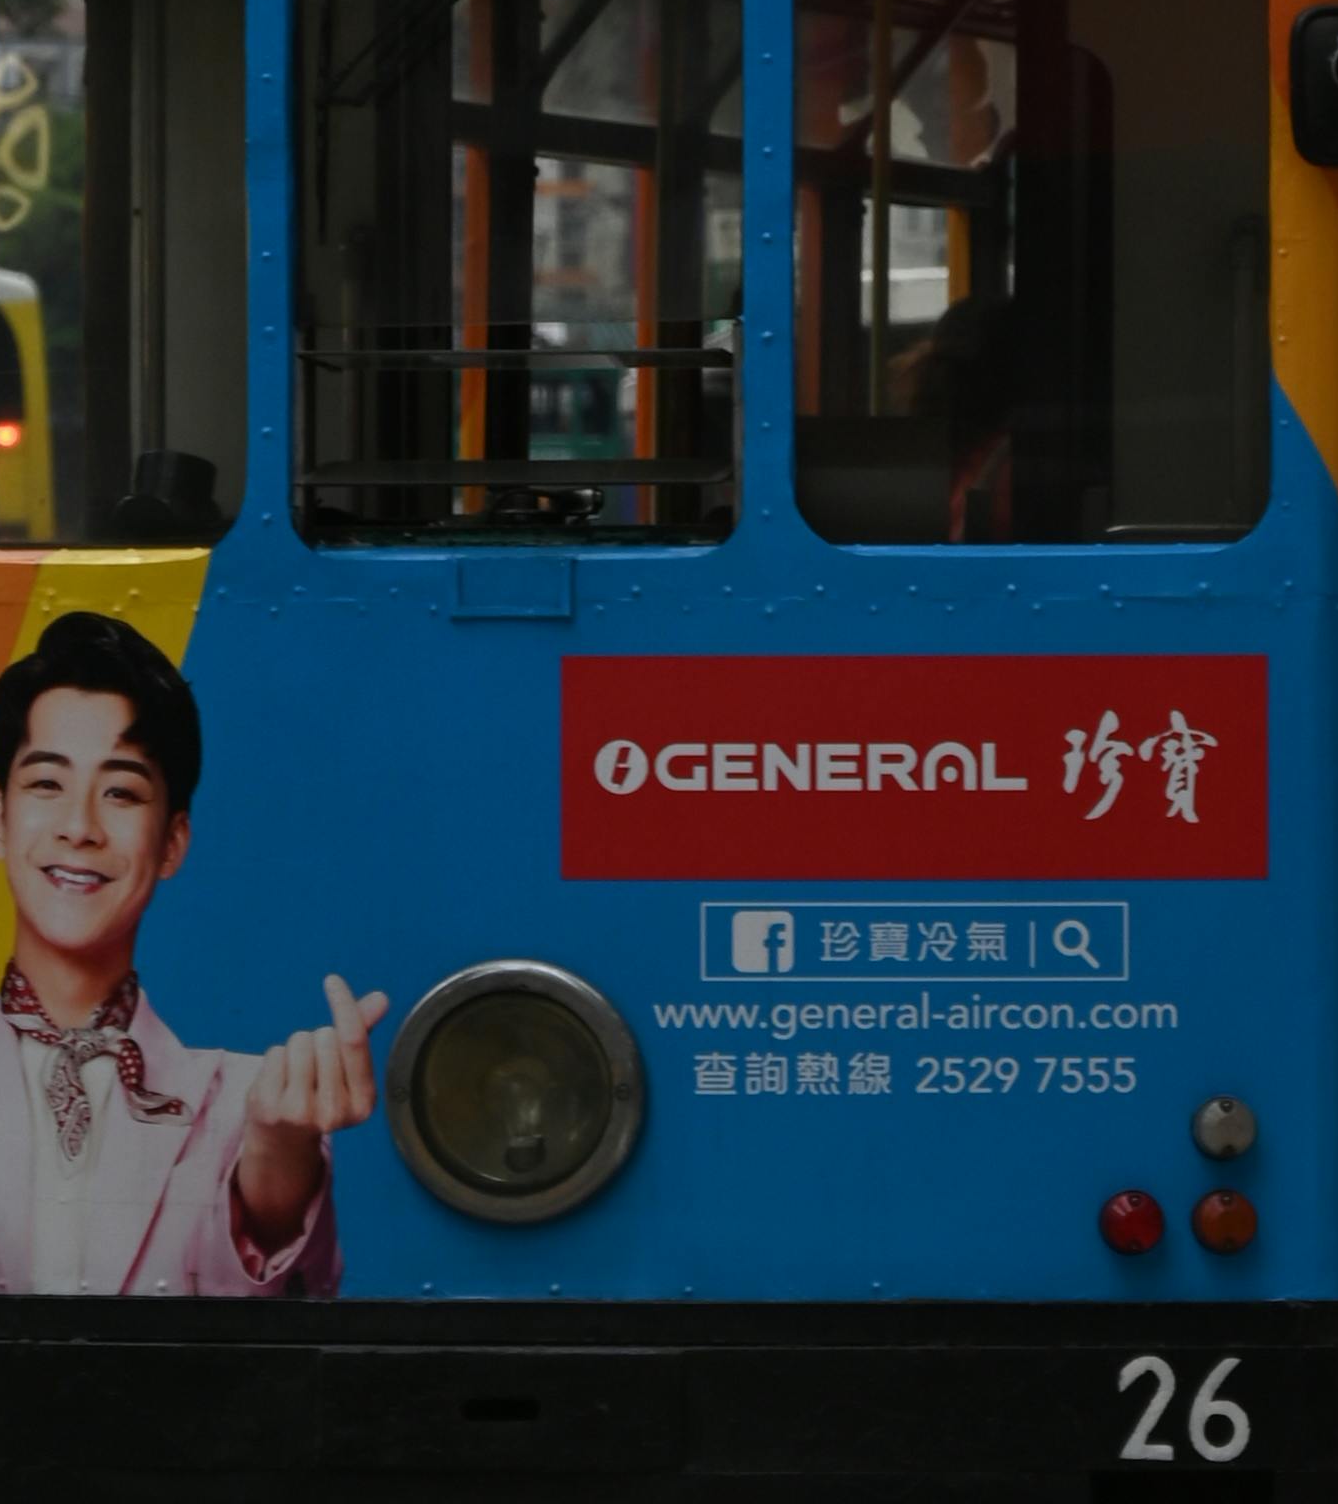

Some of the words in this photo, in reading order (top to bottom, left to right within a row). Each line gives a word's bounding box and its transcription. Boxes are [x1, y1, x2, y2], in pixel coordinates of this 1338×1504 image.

[653, 741, 1029, 793] GENERAL
[1062, 709, 1219, 824] 珍寶
[819, 920, 1009, 964] 珍寶冷氣
[653, 993, 1180, 1040] www.general-aircon.com
[693, 1051, 893, 1097] 查詢熱線
[915, 1055, 1020, 1095] 2529
[1037, 1054, 1138, 1094] 7555
[1118, 1355, 1251, 1462] 26
